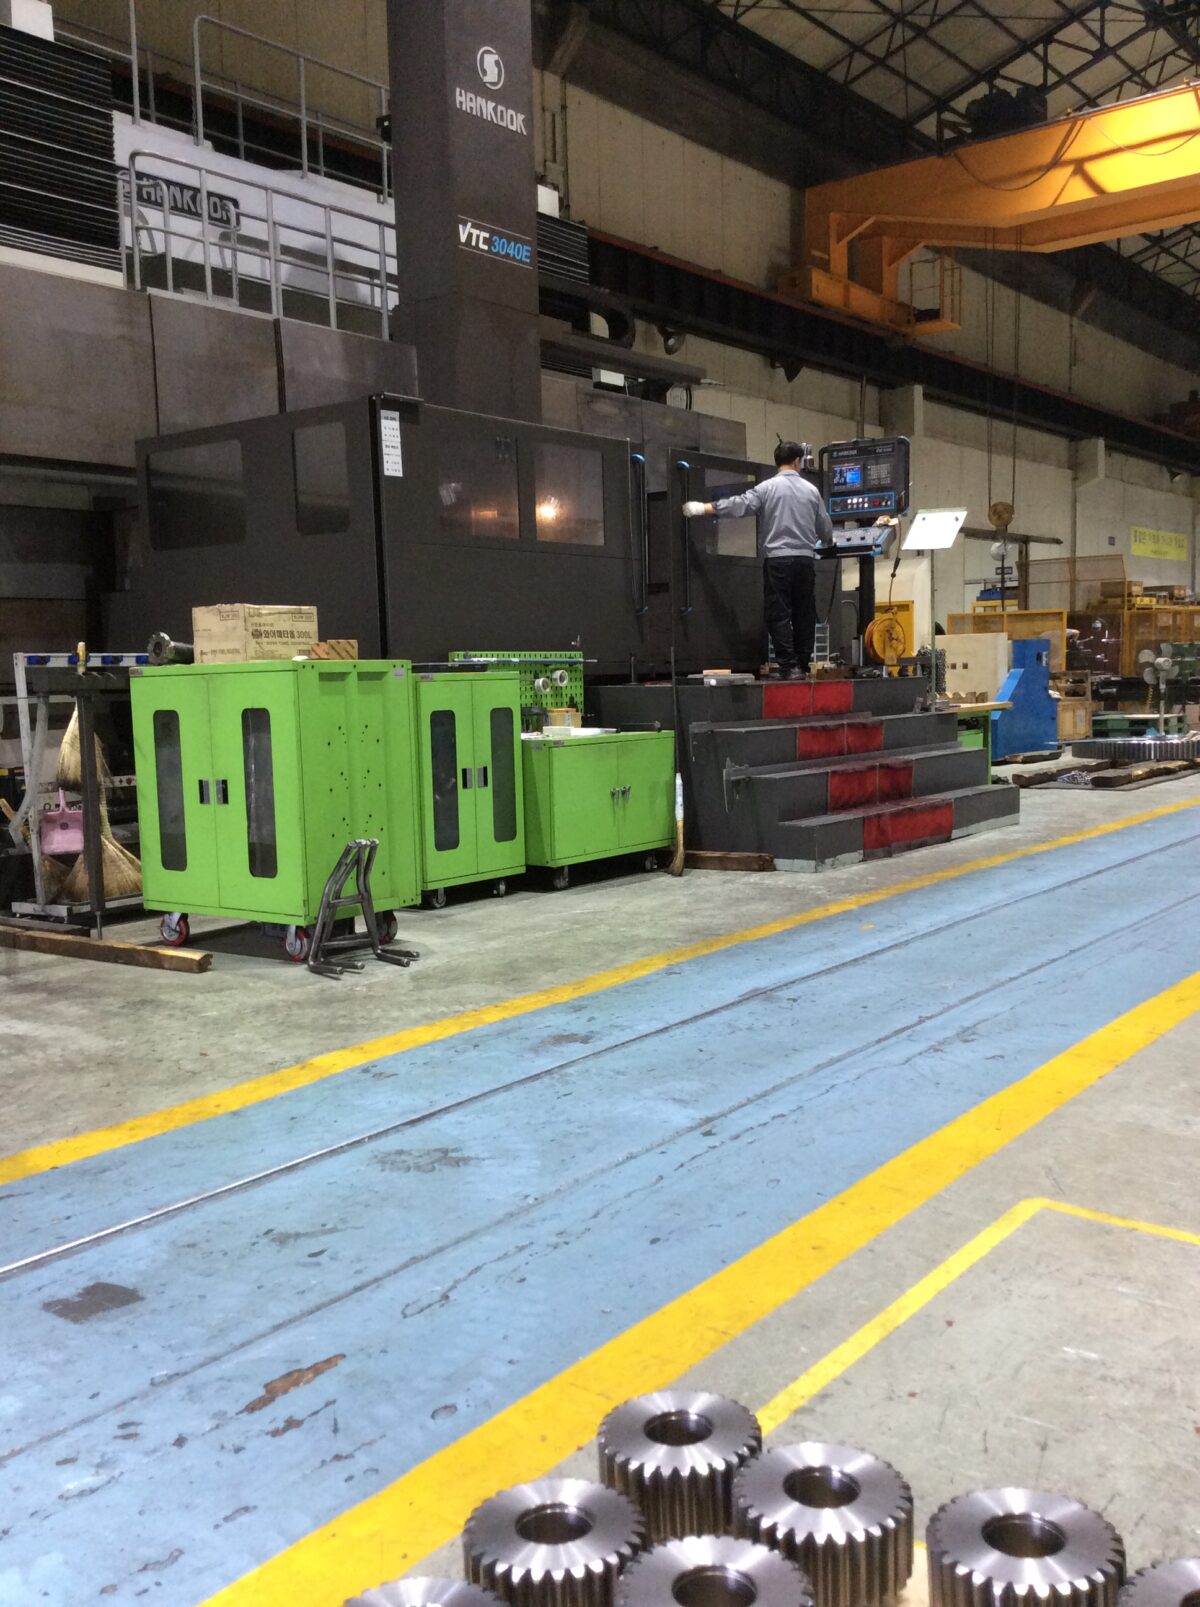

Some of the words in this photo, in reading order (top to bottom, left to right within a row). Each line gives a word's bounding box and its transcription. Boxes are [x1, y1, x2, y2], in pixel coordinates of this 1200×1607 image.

[456, 87, 527, 136] HANKOOK
[458, 221, 490, 251] VTC
[491, 235, 532, 263] 3040E
